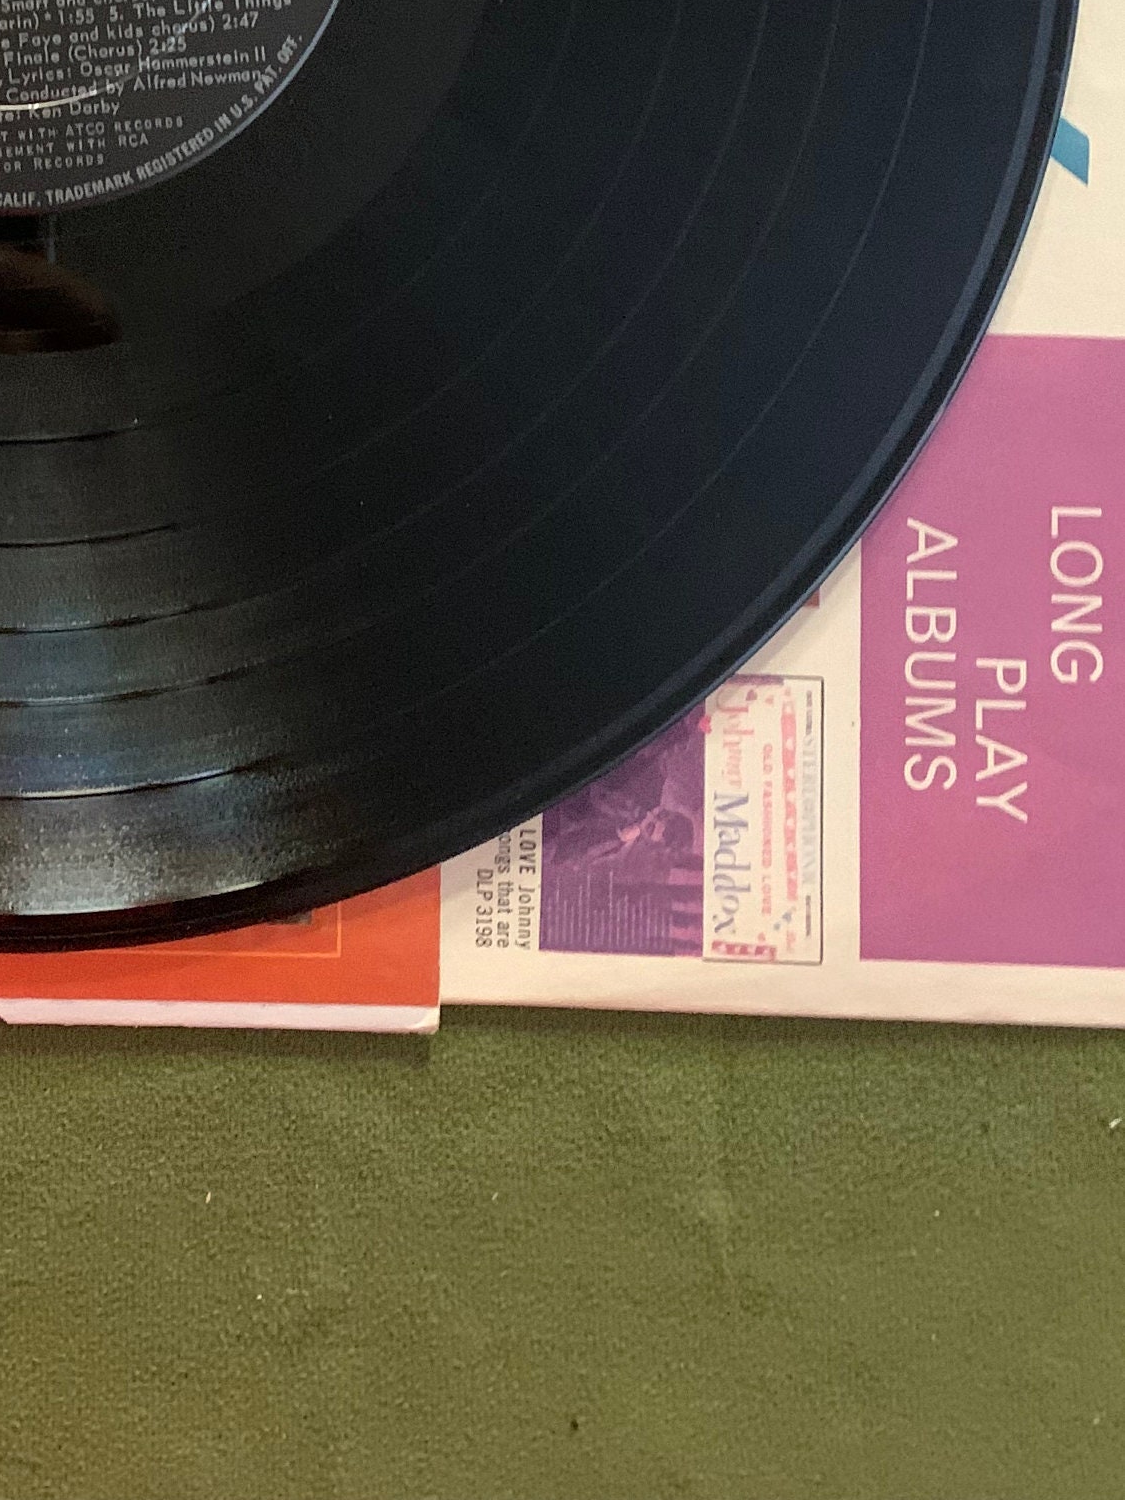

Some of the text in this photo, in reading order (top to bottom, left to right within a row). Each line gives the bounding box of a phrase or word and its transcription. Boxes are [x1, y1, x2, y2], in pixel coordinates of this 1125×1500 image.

[109, 5, 123, 22] 5.
[133, 2, 166, 19] The
[19, 31, 62, 53] Faye
[70, 25, 99, 43] and
[107, 22, 143, 40] kids
[222, 11, 259, 30] 2:47
[3, 44, 60, 68] Finale
[68, 38, 143, 62] (Chorus)
[9, 66, 72, 85] Lyrics:
[81, 60, 130, 77] Oscar
[138, 54, 249, 73] Hammerstein
[107, 81, 124, 96] by
[133, 74, 186, 91] Alfred
[191, 69, 261, 87] Newman
[69, 99, 119, 115] Darby
[18, 127, 56, 141] WITH
[66, 122, 105, 136] ATCO
[114, 116, 184, 132] RECORDS
[45, 170, 133, 205] TRADEMARK
[136, 127, 214, 181] REGISTERED
[214, 113, 232, 133] IN
[67, 138, 105, 152] WITH
[34, 154, 104, 170] RECORDS
[1050, 505, 1104, 684] LONG
[904, 518, 958, 792] ALBUMS
[976, 657, 1028, 823] PLAY
[712, 791, 751, 935] Maddox
[496, 882, 514, 914] that
[511, 828, 537, 949] LOVE Johnny
[475, 868, 494, 949] DLP 3198
[496, 921, 512, 948] are
